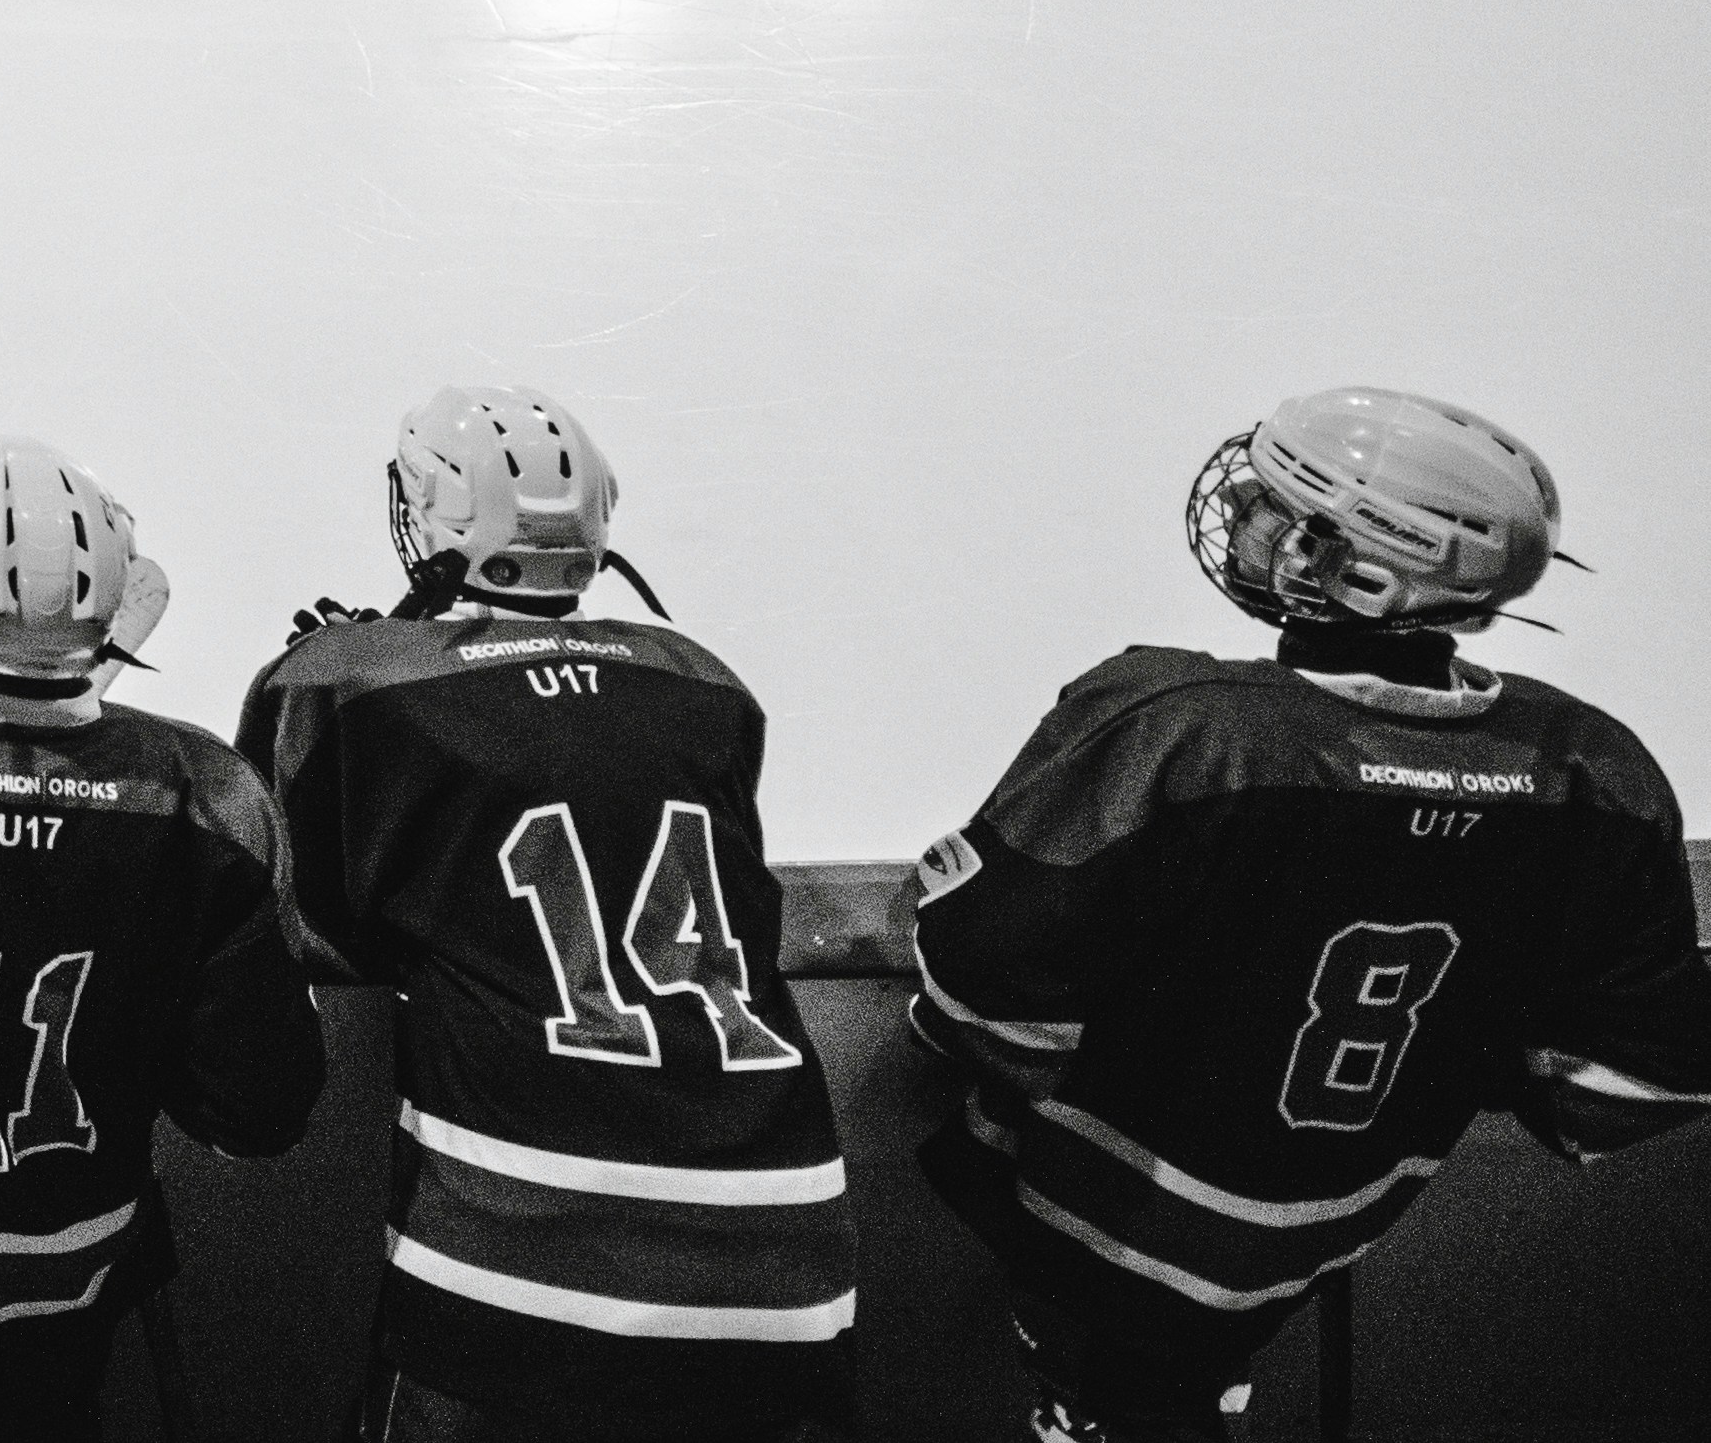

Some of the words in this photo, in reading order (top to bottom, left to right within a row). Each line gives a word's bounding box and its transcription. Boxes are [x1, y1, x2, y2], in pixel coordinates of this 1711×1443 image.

[460, 636, 560, 661] DECATHLON
[526, 664, 600, 698] U17
[47, 777, 120, 801] OROKS
[1359, 762, 1456, 794] DECATHLON
[1460, 768, 1536, 797] OROKS
[1409, 807, 1483, 839] U17
[497, 799, 804, 1072] 14
[1277, 919, 1461, 1132] 8
